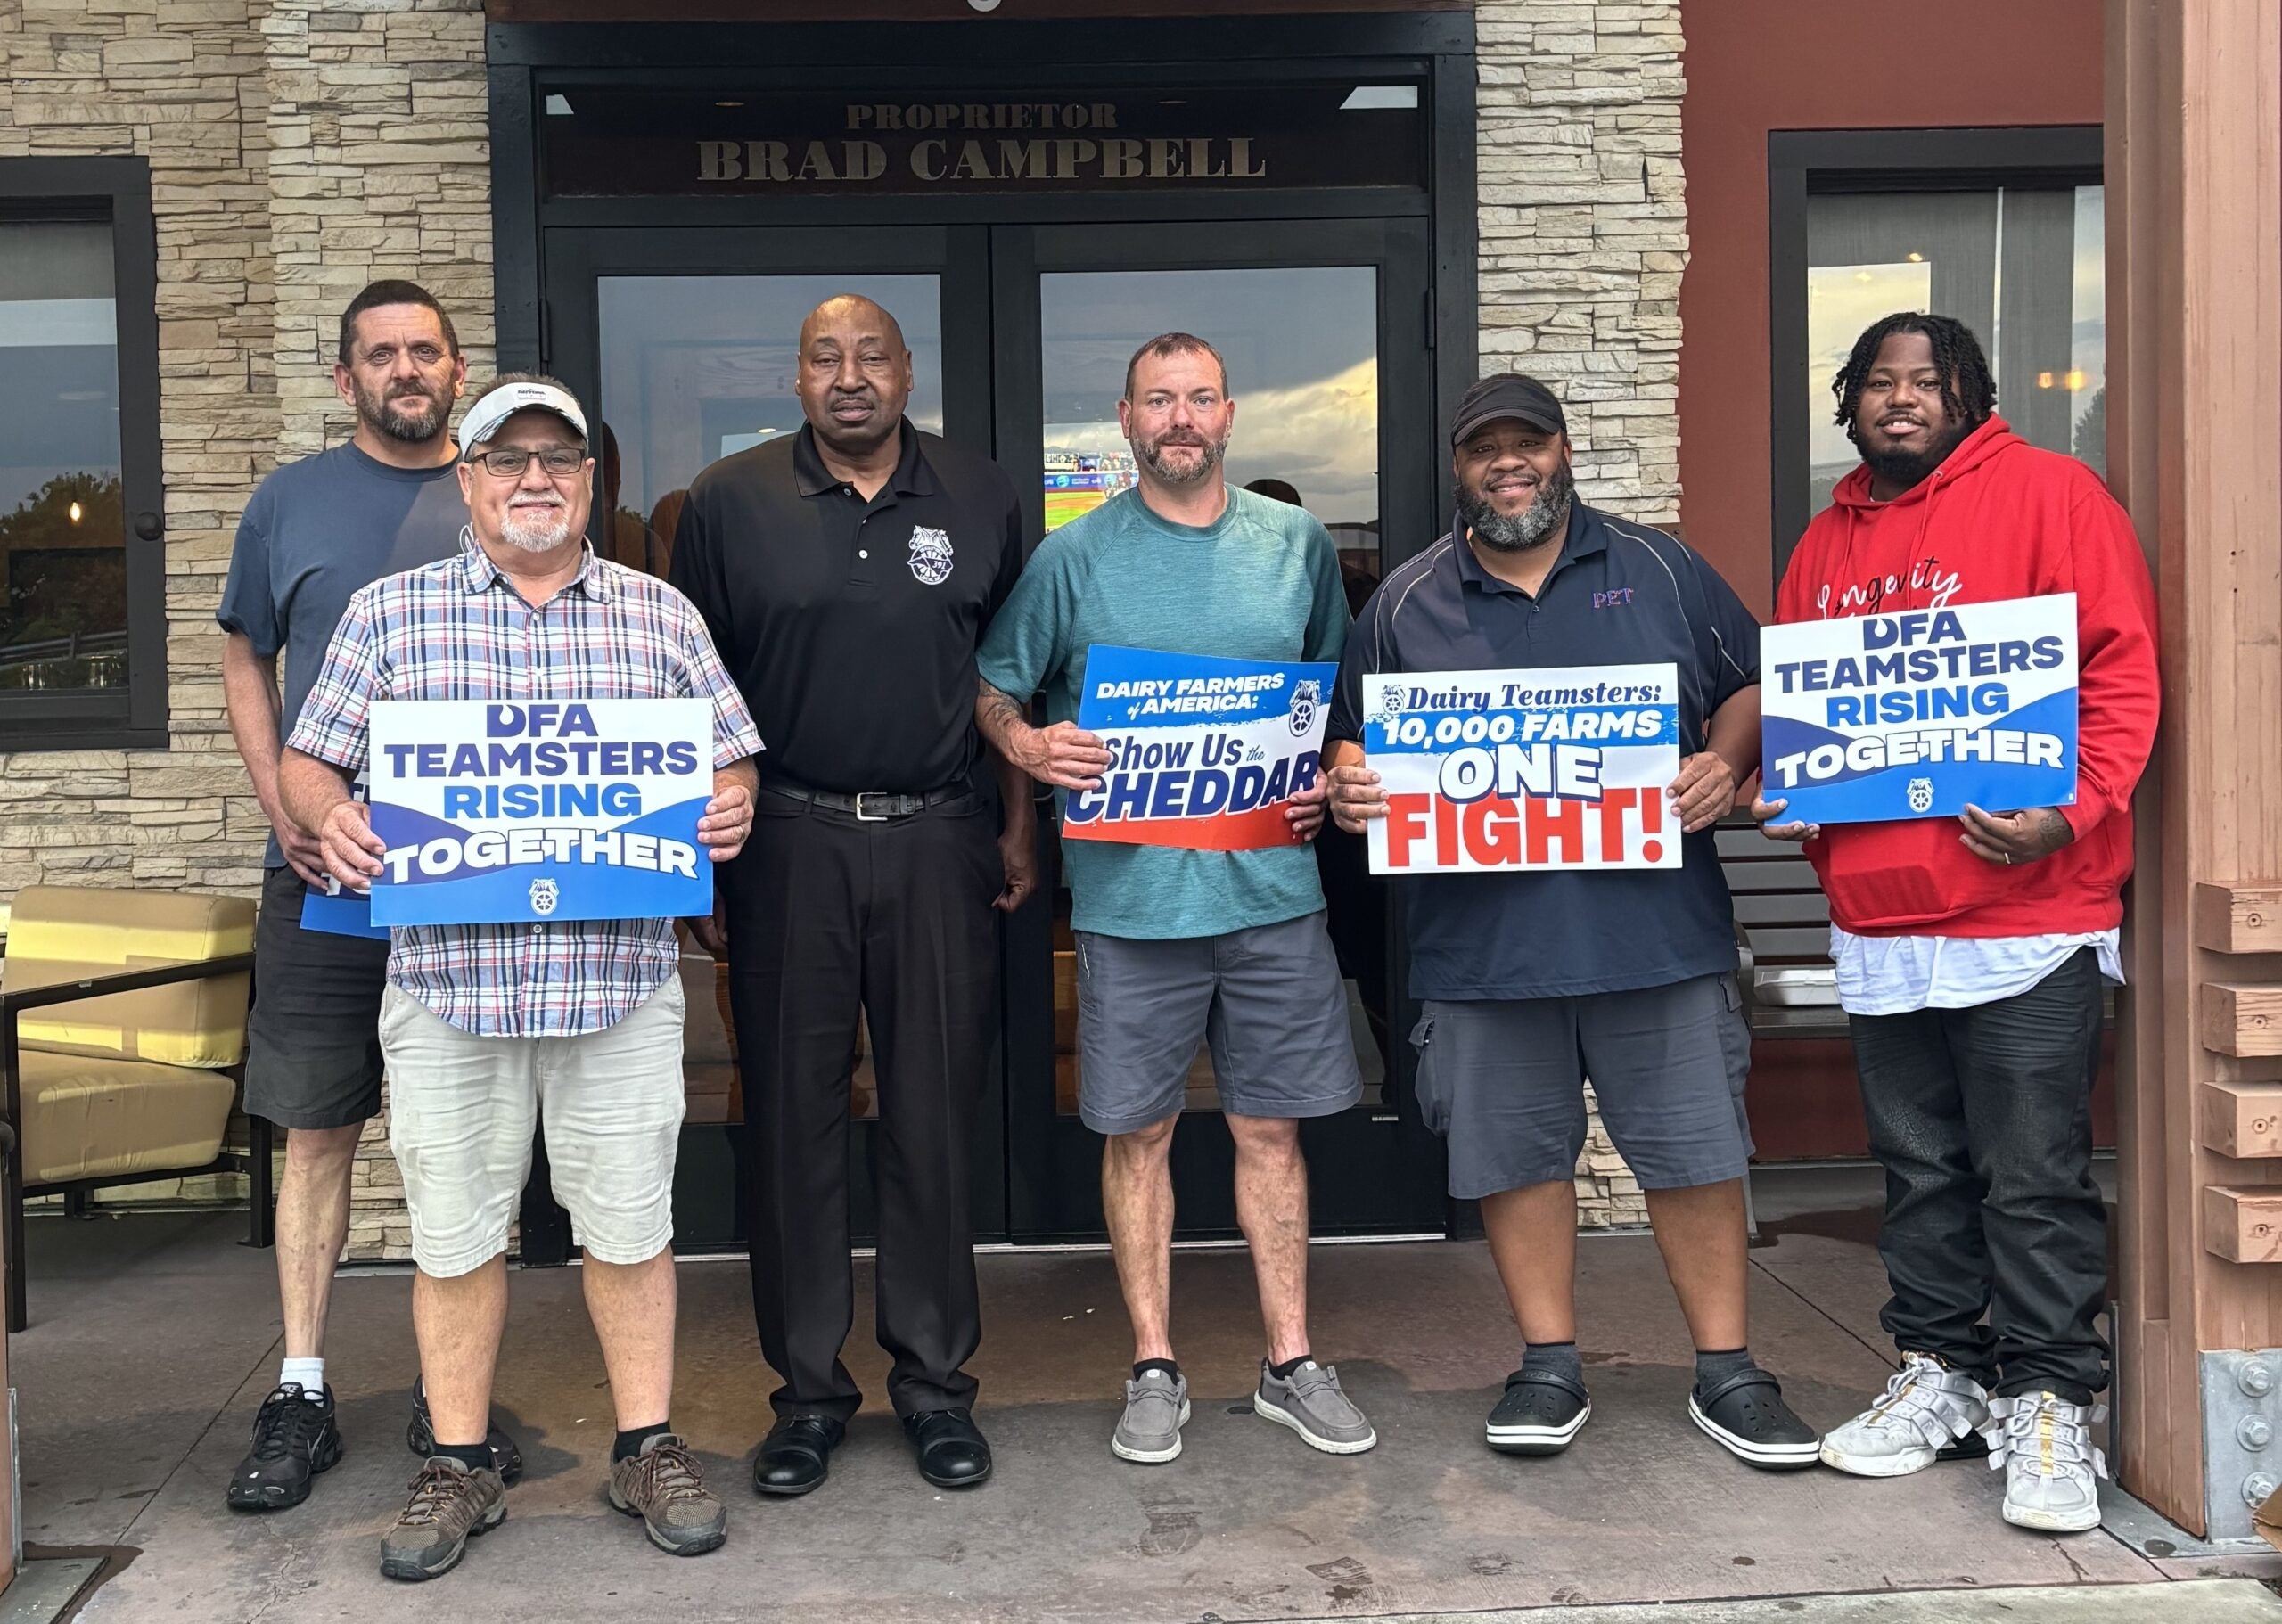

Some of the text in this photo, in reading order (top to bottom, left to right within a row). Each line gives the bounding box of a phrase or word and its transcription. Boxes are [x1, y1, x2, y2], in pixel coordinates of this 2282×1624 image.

[846, 103, 1119, 130] PROPRIETOR
[697, 137, 1267, 182] BRAD CAMPBELL
[932, 561, 947, 570] 391
[1593, 587, 1634, 608] PET
[1817, 555, 1963, 619] Lngevity
[1863, 610, 1966, 651] DFA
[1774, 636, 2064, 693] TEAMSTERS
[1096, 672, 1285, 700] DAIRY FARMERS
[1406, 682, 1662, 713] Dairy Teamsters:
[1826, 682, 2009, 727] RISING
[487, 703, 599, 738] DFA
[1127, 694, 1259, 720] of AMERICA:
[1383, 709, 1662, 749] 10,000 FARMS
[384, 741, 698, 778] TEAMSTERS
[1105, 733, 1266, 772] Show Us the
[1439, 742, 1604, 802] ONE
[1775, 727, 2065, 789] TOGETHER
[444, 783, 642, 819] RISING
[1066, 750, 1321, 824] CHEDDAR
[1385, 787, 1663, 867] FIGHT!
[383, 828, 700, 884] TOGETHER
